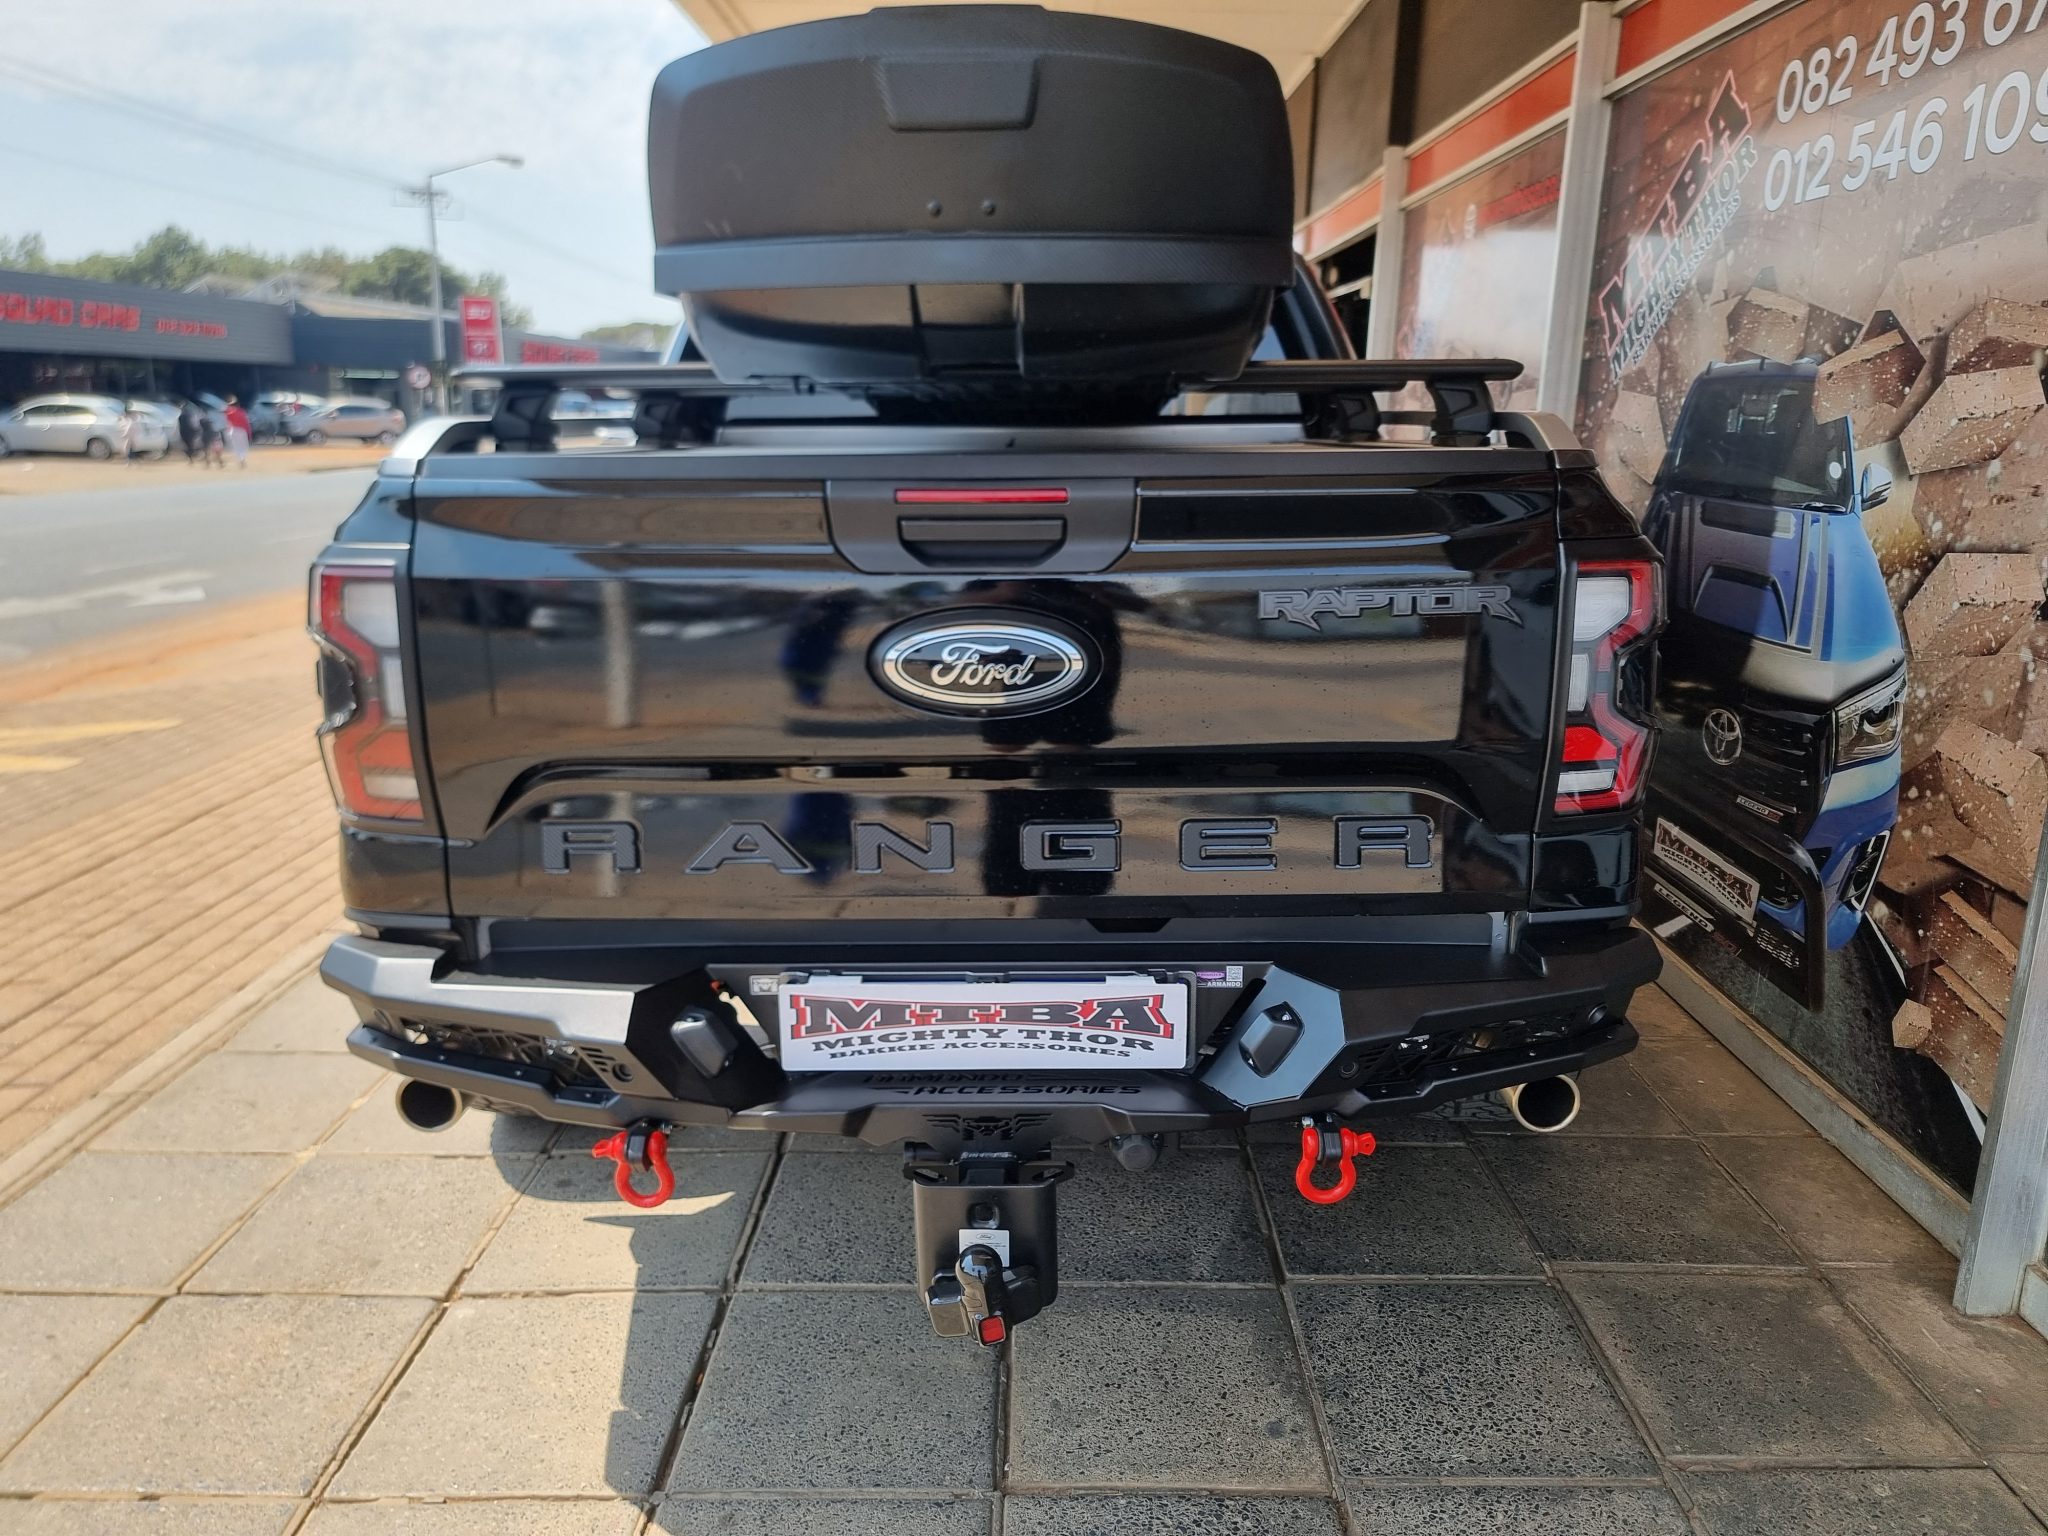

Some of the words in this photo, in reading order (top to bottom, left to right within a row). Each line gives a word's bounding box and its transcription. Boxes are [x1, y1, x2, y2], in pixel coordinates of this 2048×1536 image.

[1777, 36, 1858, 124] 082
[1865, 0, 1969, 87] 493
[1764, 134, 1835, 212] 012
[1841, 97, 1948, 191] 546
[1599, 69, 1752, 355] MTBA
[1607, 234, 1689, 384] MIGHTY
[1680, 135, 1758, 252] THOR
[1258, 585, 1524, 631] RAPTOR
[931, 642, 1036, 686] Ford
[541, 814, 1434, 876] RANGER
[1660, 846, 1708, 875] MIGHTY
[1709, 874, 1746, 910] THOR
[1658, 887, 1708, 928] LEGEND
[790, 994, 1174, 1039] MTBA
[812, 1028, 1005, 1052] MIGHTY
[1018, 1028, 1154, 1051] THOR
[829, 1043, 936, 1059] BAKKIE
[944, 1042, 1131, 1057] ACCESSORIES
[913, 1084, 1142, 1095] ACCESSORIES
